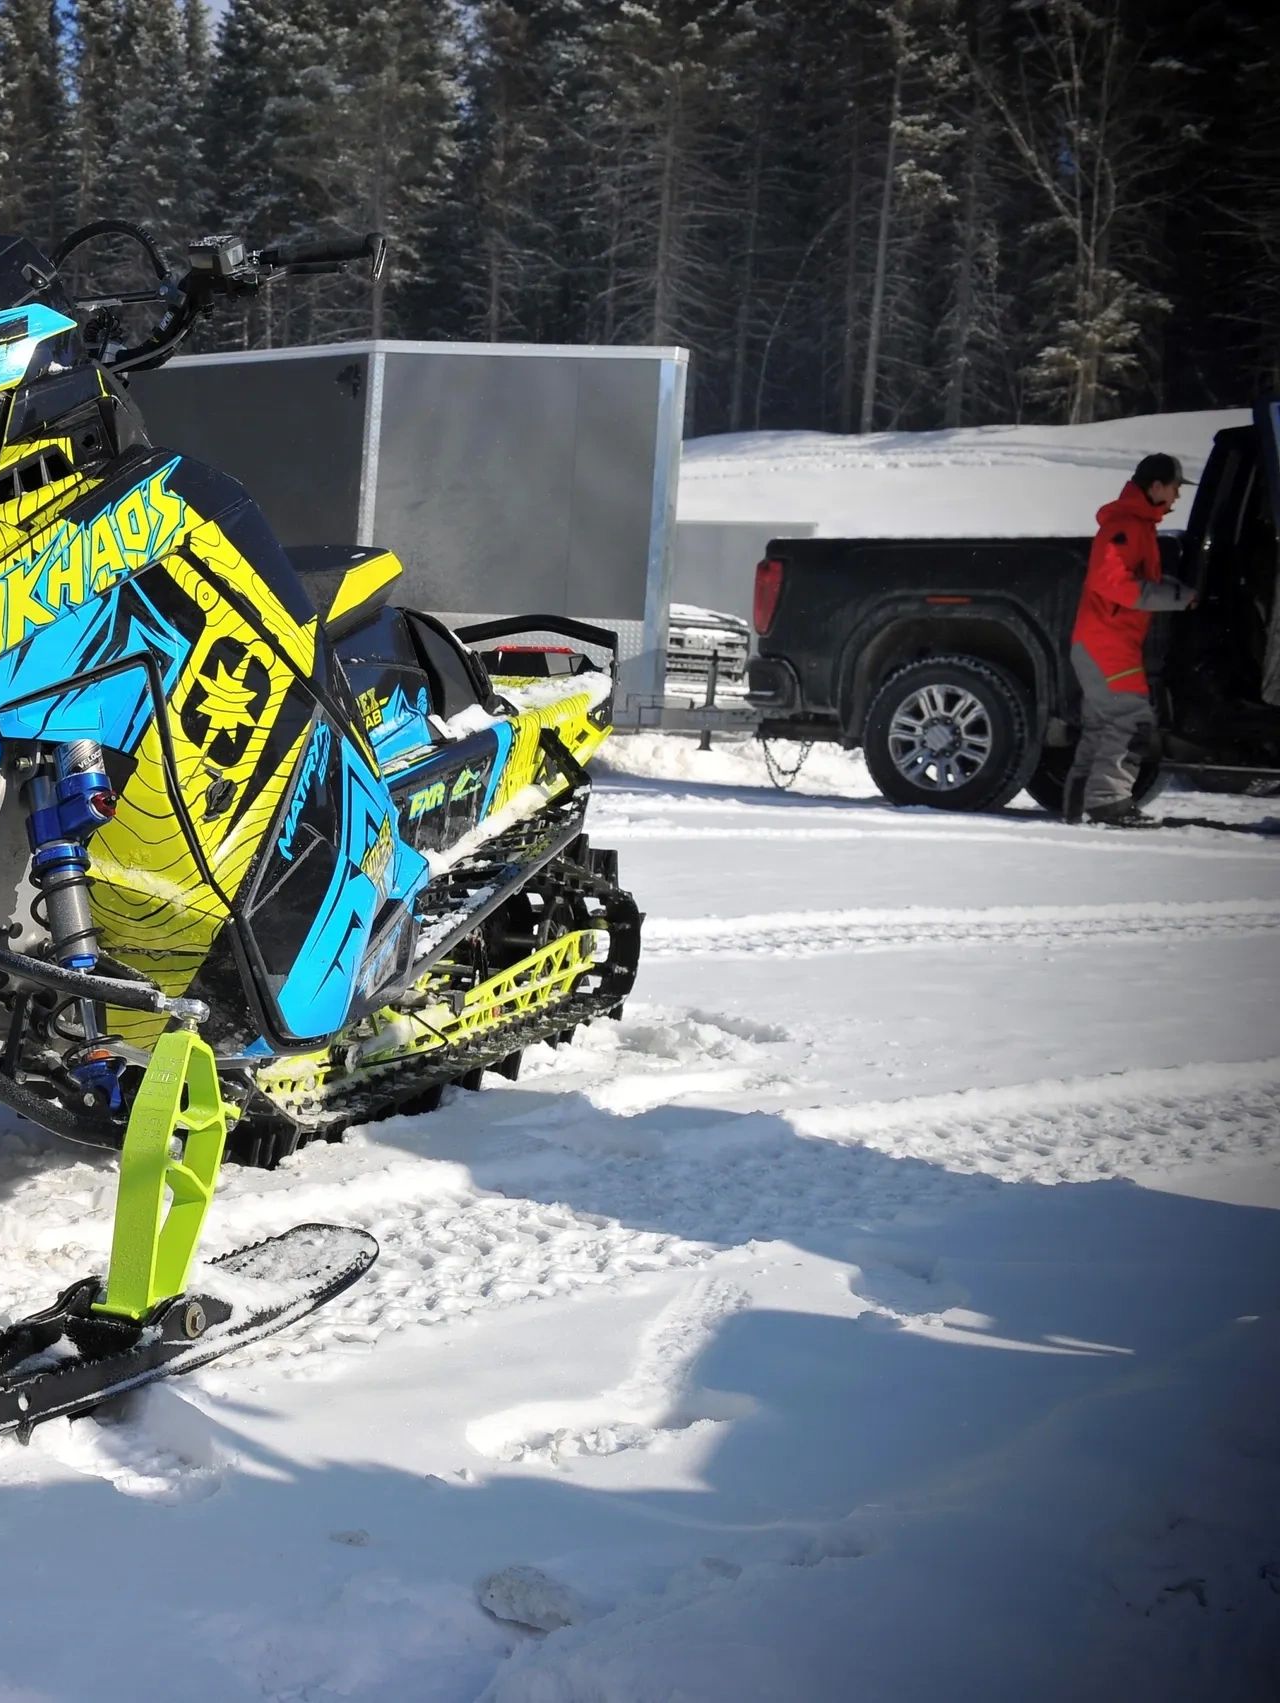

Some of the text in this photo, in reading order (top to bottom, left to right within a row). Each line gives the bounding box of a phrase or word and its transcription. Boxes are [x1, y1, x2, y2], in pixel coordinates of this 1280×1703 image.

[356, 687, 380, 717] EX
[365, 709, 382, 732] AB
[78, 749, 103, 769] VELOC
[278, 721, 328, 861] MATRYX
[408, 781, 446, 820] FXR
